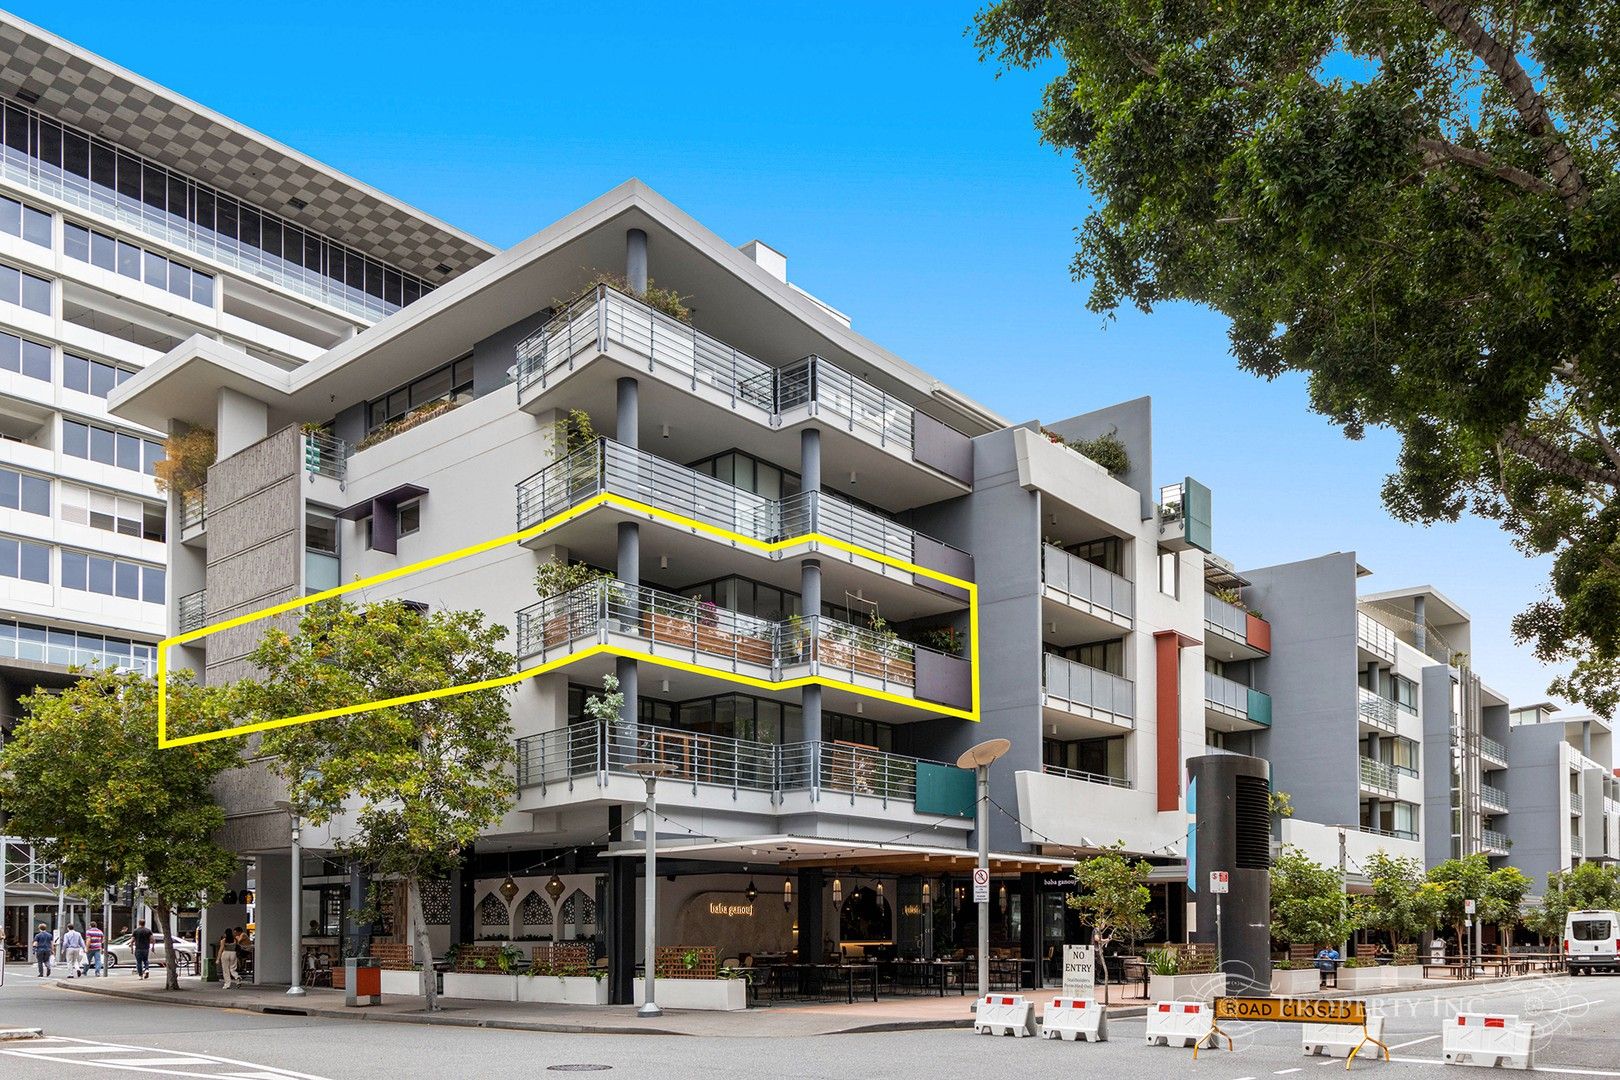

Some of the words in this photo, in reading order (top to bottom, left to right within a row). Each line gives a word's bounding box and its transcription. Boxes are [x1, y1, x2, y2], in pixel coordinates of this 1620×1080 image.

[710, 902, 728, 914] baba
[1073, 951, 1085, 960] NO
[1065, 963, 1092, 972] ENTRY
[1226, 1002, 1272, 1016] ROAD
[1282, 1003, 1351, 1019] CLOSED
